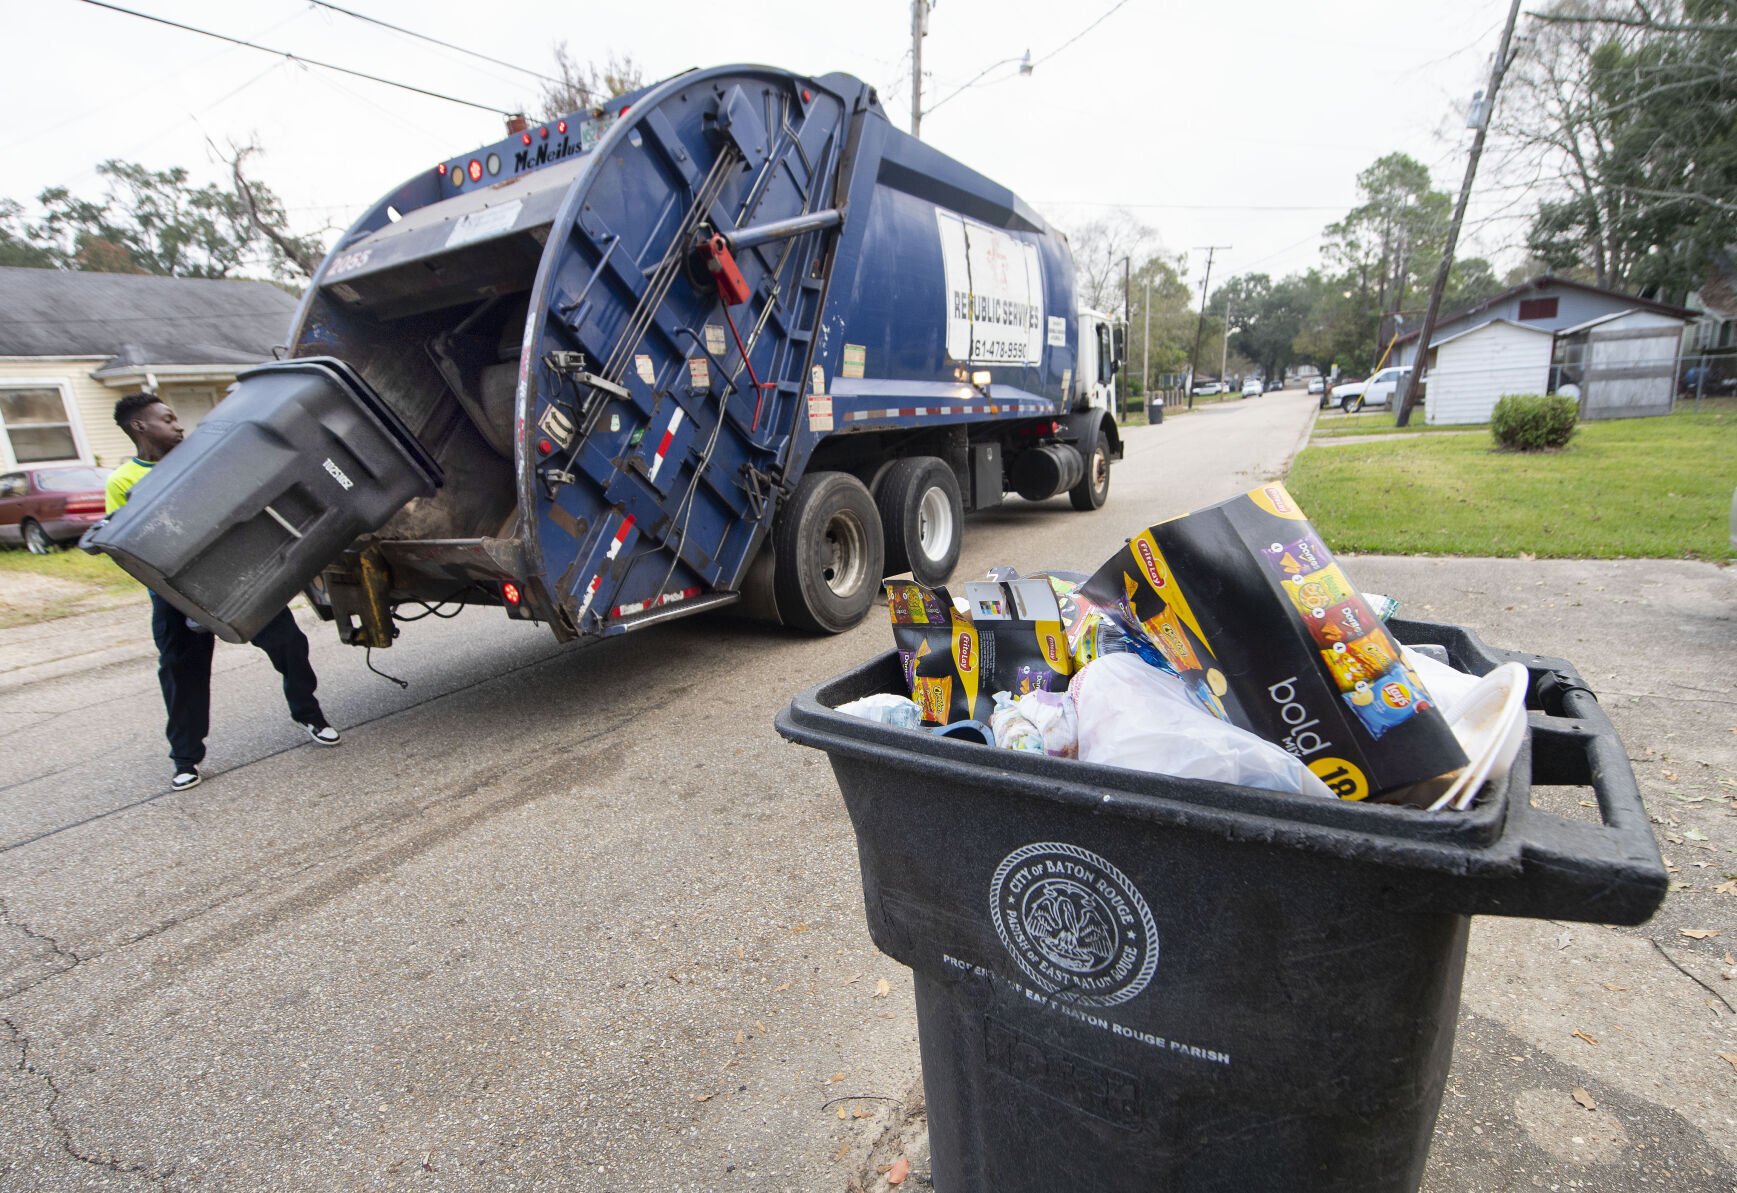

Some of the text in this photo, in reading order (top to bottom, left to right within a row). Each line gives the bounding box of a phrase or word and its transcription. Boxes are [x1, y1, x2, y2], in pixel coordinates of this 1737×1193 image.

[514, 136, 583, 173] McNeilus
[1267, 676, 1333, 757] bold
[1320, 765, 1358, 802] 18
[1010, 860, 1136, 926] CITY OF BATON ROUGE
[1006, 909, 1031, 951] PARISH
[1028, 951, 1040, 963] OF
[1039, 960, 1071, 985] EAST
[1112, 1022, 1166, 1048] ROUGE
[1170, 1041, 1231, 1065] PARISH
